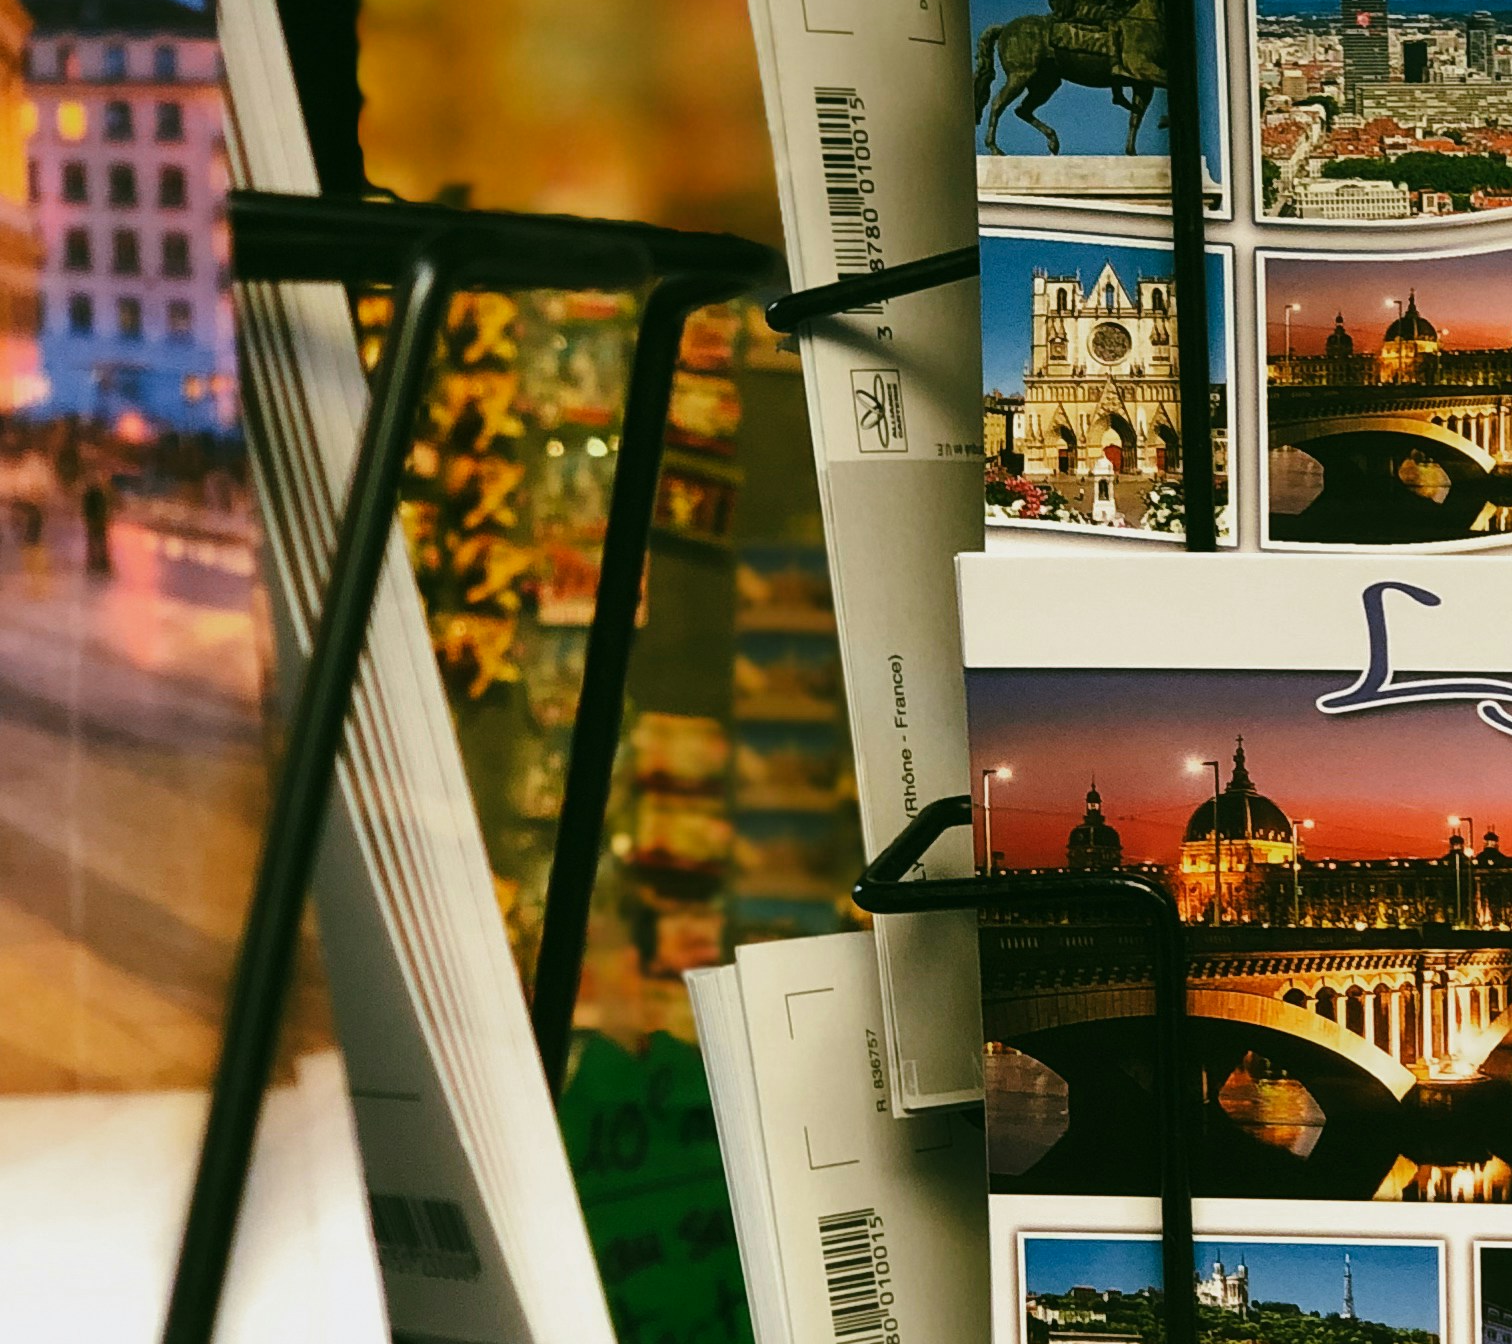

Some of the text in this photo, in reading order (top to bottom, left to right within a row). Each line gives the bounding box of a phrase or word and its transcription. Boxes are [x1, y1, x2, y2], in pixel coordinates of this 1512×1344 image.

[850, 96, 875, 195] 010015
[864, 206, 890, 305] 8780
[891, 653, 908, 732] France)
[900, 749, 918, 819] (Rhône
[865, 1028, 885, 1090] 836757
[868, 1214, 894, 1308] 010015
